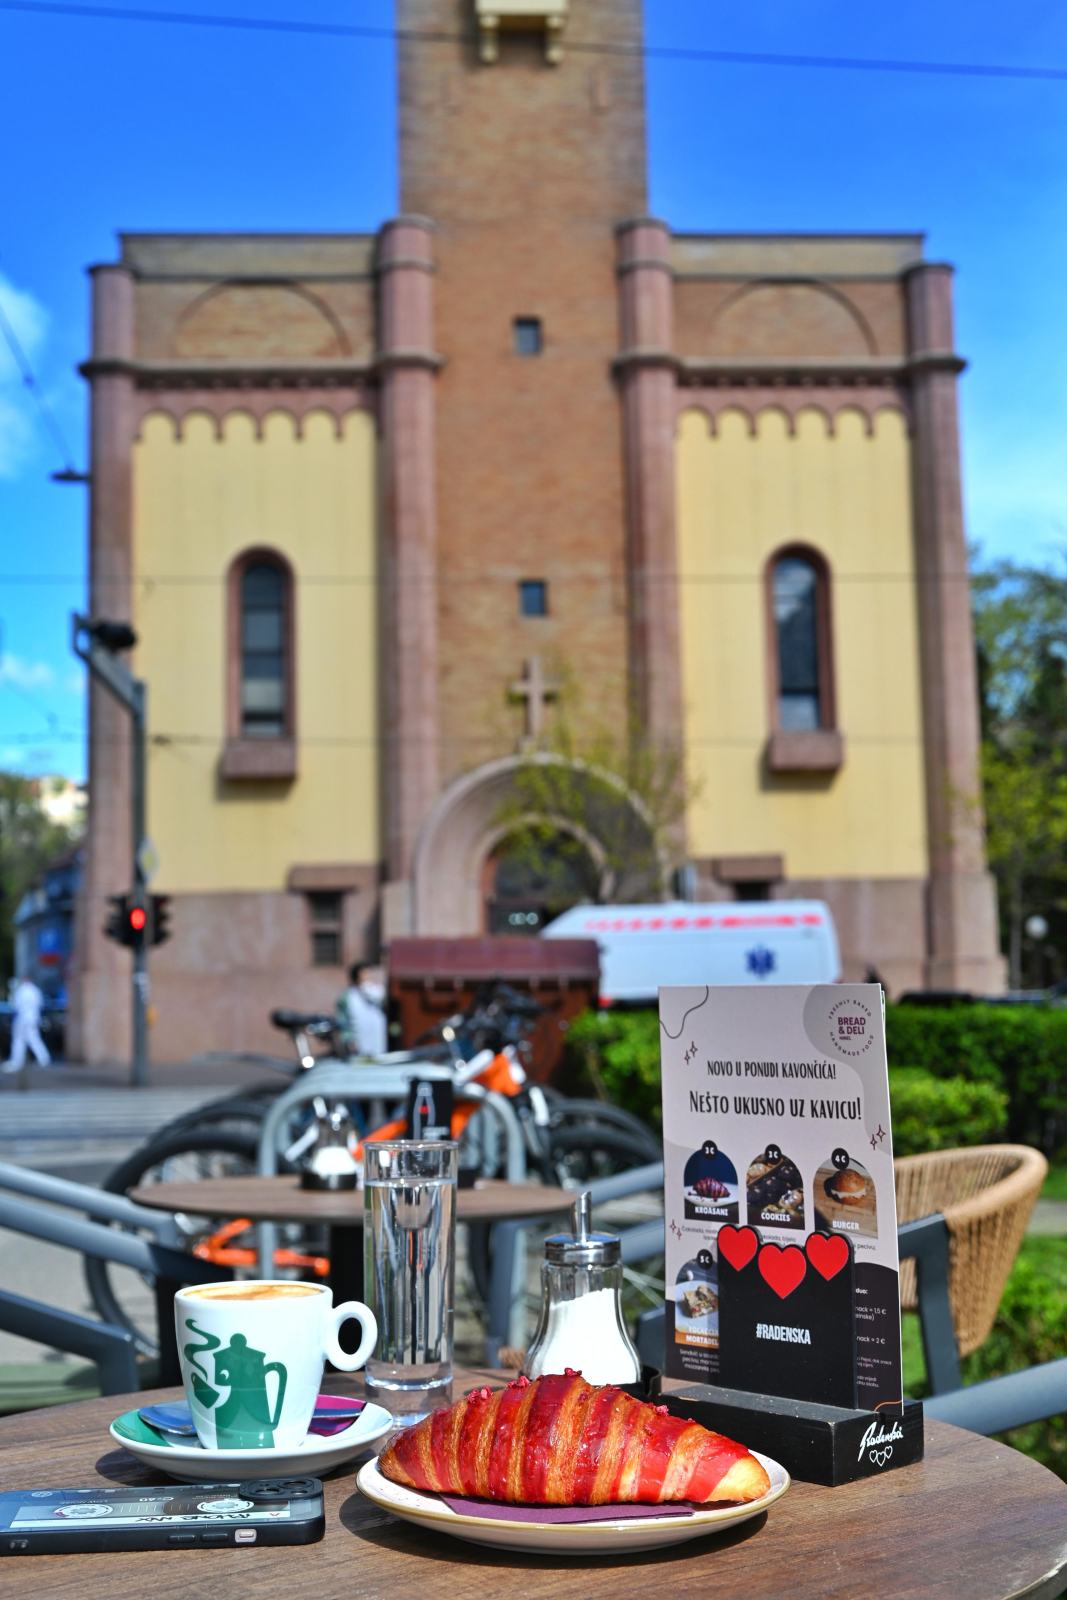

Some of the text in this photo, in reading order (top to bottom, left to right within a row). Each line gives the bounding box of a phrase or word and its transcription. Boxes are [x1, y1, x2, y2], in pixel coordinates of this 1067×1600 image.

[838, 1016, 866, 1026] BREAD
[838, 1026, 865, 1035] & DELI
[707, 1059, 836, 1080] NOVO U PONUDI KAVONČIĆA!
[734, 1096, 784, 1117] UKUSNO
[790, 1099, 805, 1118] UZ
[810, 1097, 862, 1120] KAVICU!
[835, 1154, 840, 1163] 4
[761, 1212, 790, 1222] COOKIES
[832, 1220, 860, 1231] BURGER
[756, 1323, 811, 1345] #RADENSKA
[857, 1421, 904, 1463] Radenska
